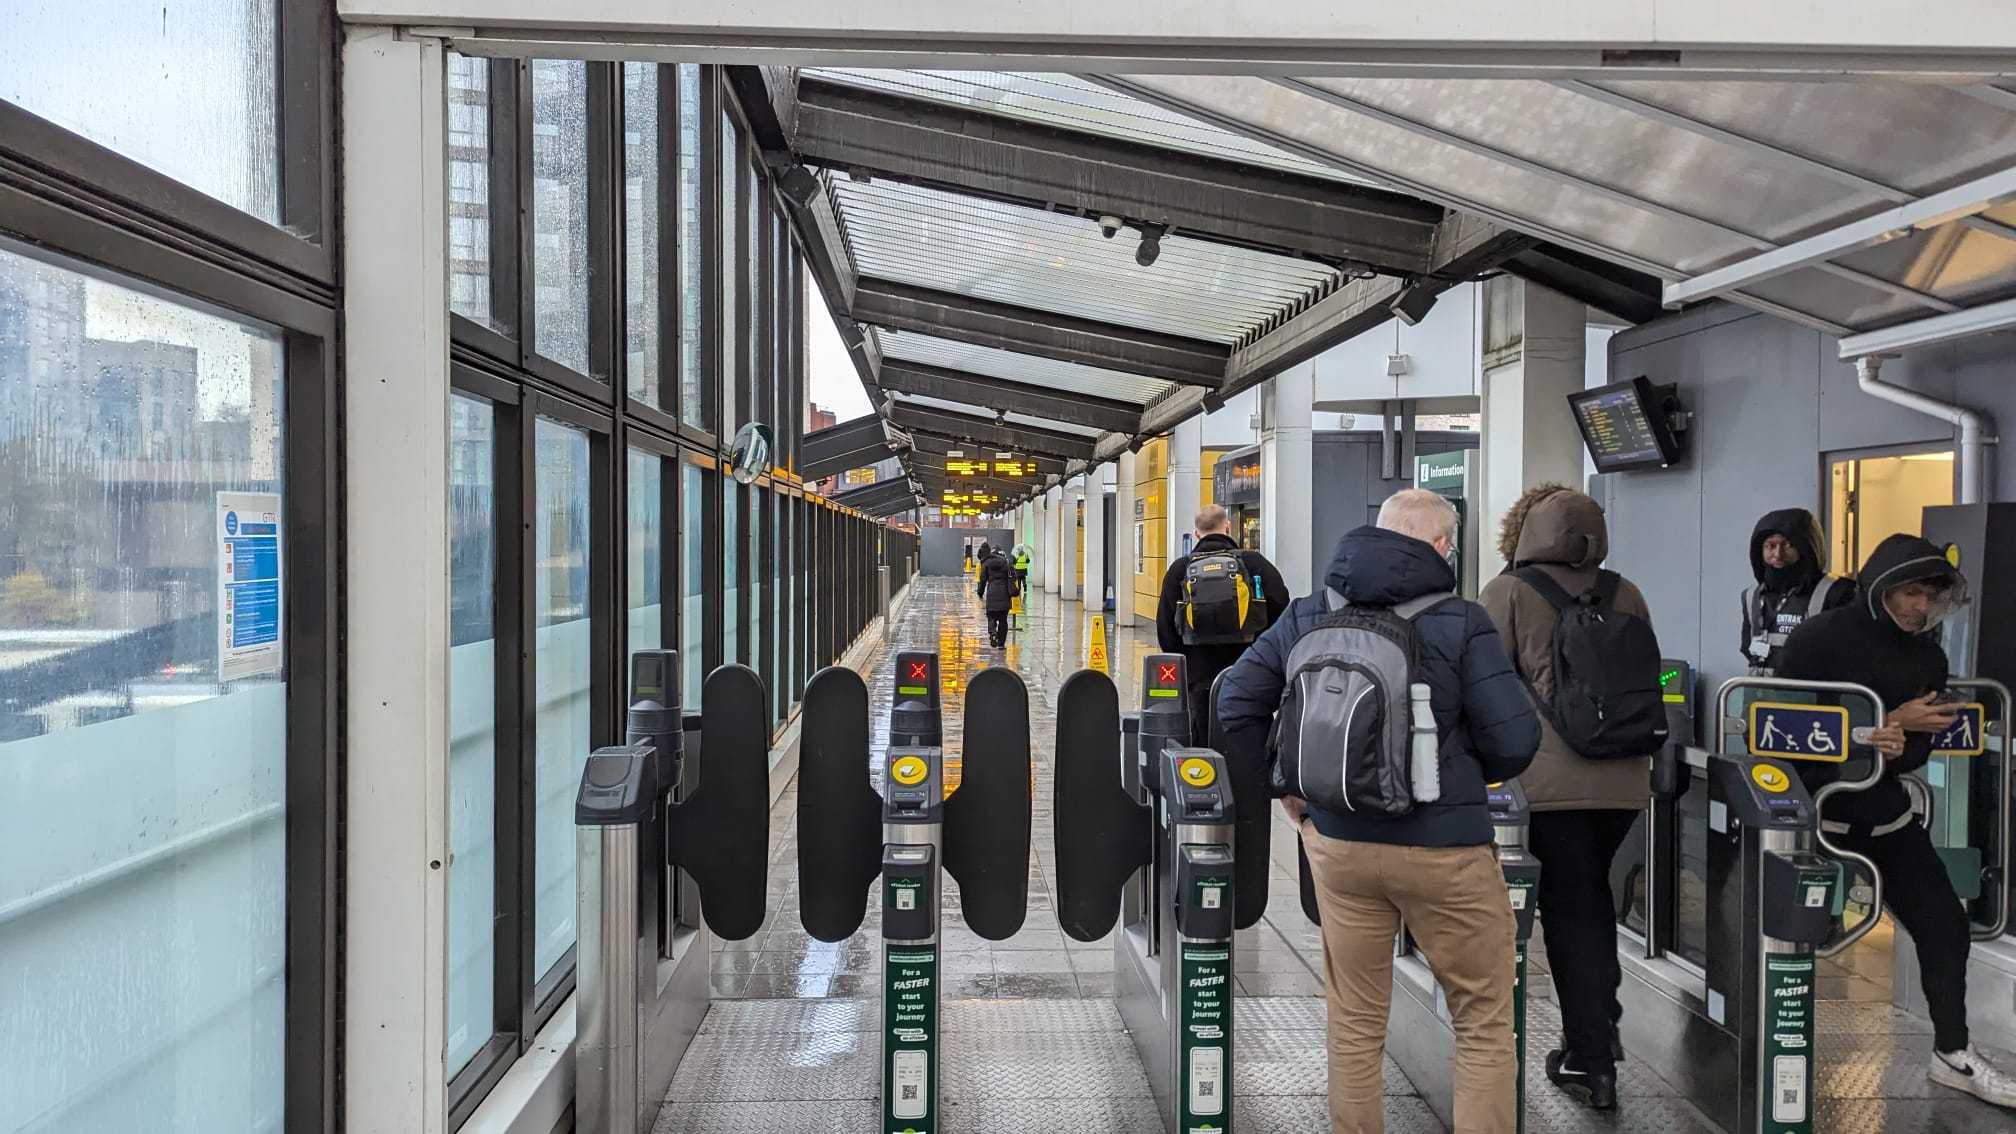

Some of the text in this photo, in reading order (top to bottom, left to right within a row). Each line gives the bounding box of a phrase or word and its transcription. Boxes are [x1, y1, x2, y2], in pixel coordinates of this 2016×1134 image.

[1430, 463, 1464, 478] Information
[902, 968, 913, 976] For
[1198, 966, 1210, 974] For
[893, 977, 930, 990] FASTER
[1189, 975, 1225, 987] FASTER
[1774, 985, 1809, 997] FASTER
[906, 1003, 925, 1011] your
[1203, 1000, 1220, 1009] your
[896, 1012, 926, 1022] journey
[1192, 1009, 1221, 1019] journey
[1776, 1019, 1805, 1028] journey
